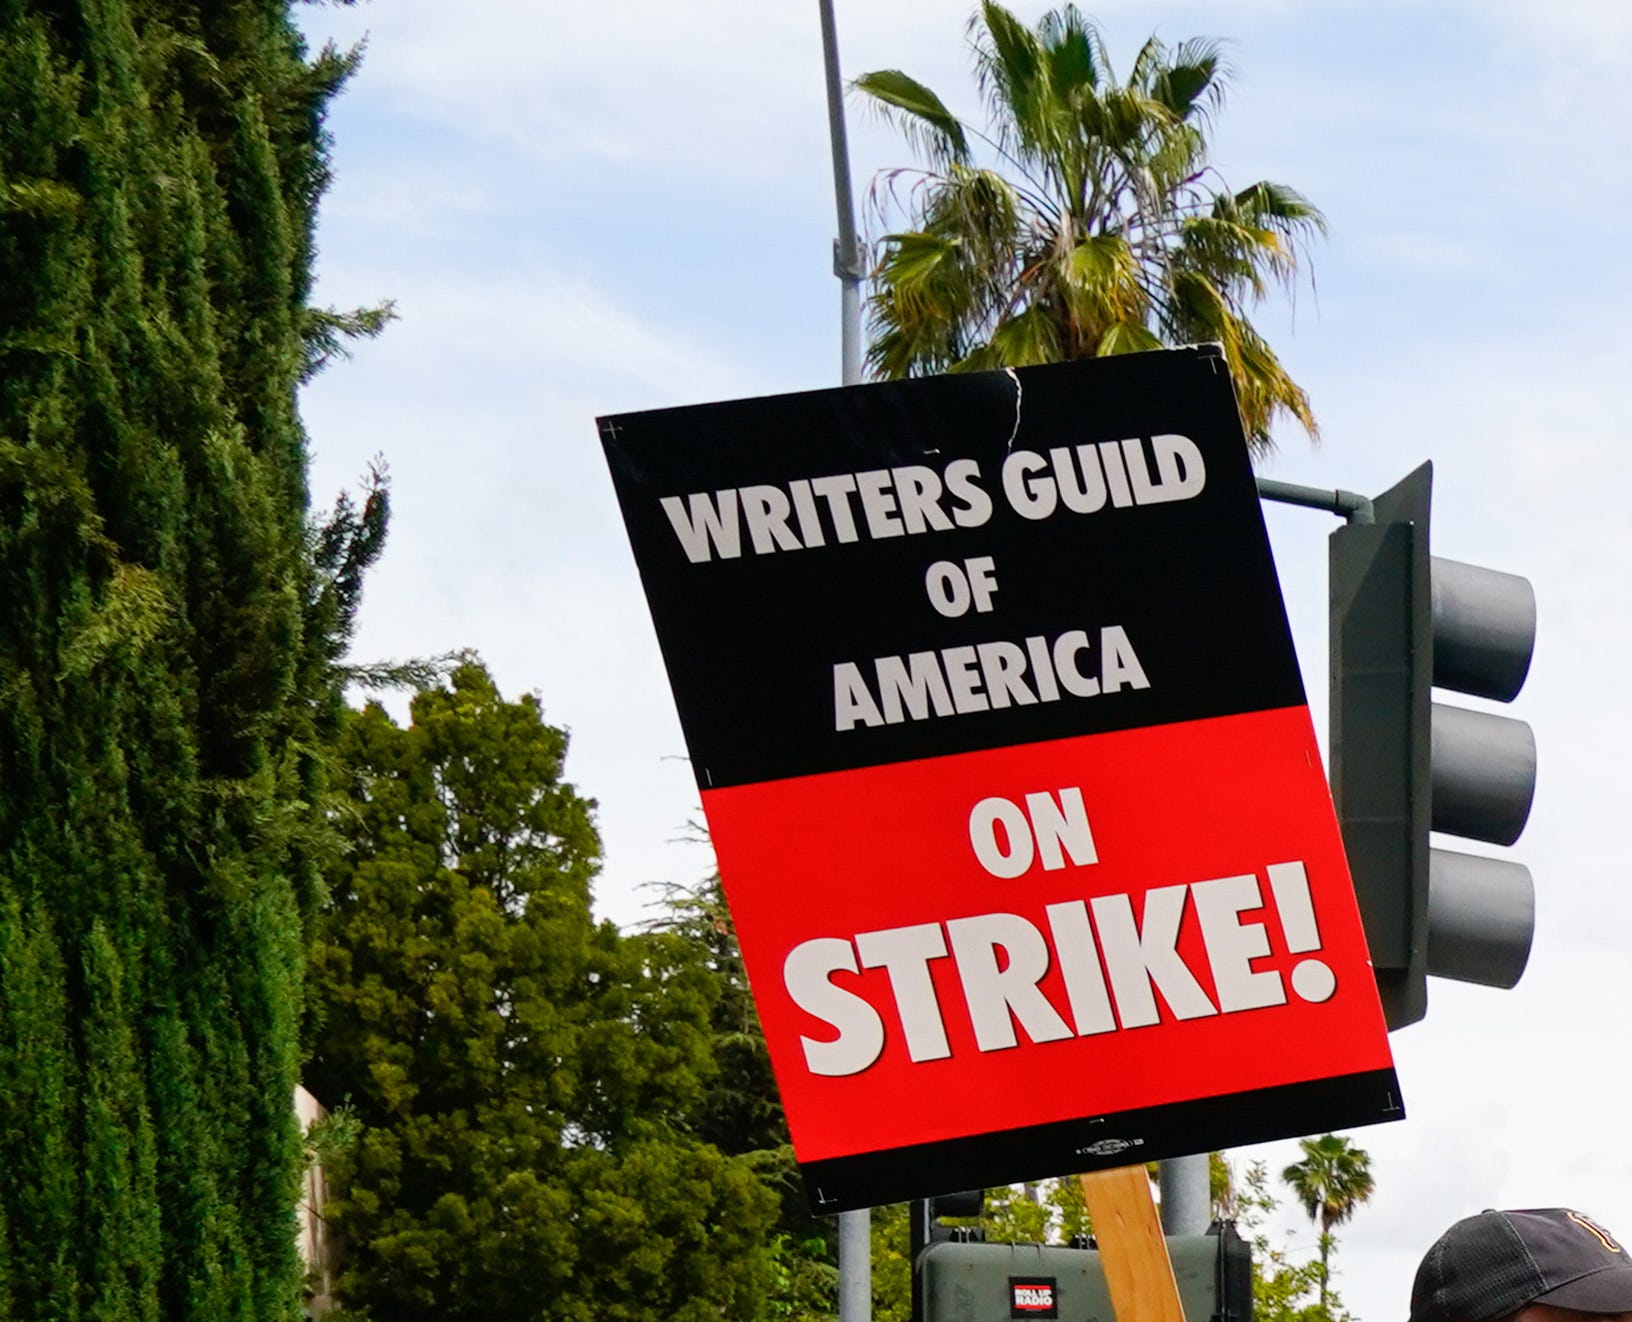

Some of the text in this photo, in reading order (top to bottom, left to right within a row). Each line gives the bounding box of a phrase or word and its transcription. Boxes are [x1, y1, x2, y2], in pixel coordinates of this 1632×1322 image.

[659, 434, 1206, 563] WRITERS GUILD
[926, 556, 999, 618] OF
[834, 624, 1151, 731] AMERICA
[969, 786, 1099, 879] ON
[783, 860, 1337, 1077] STRIKE!
